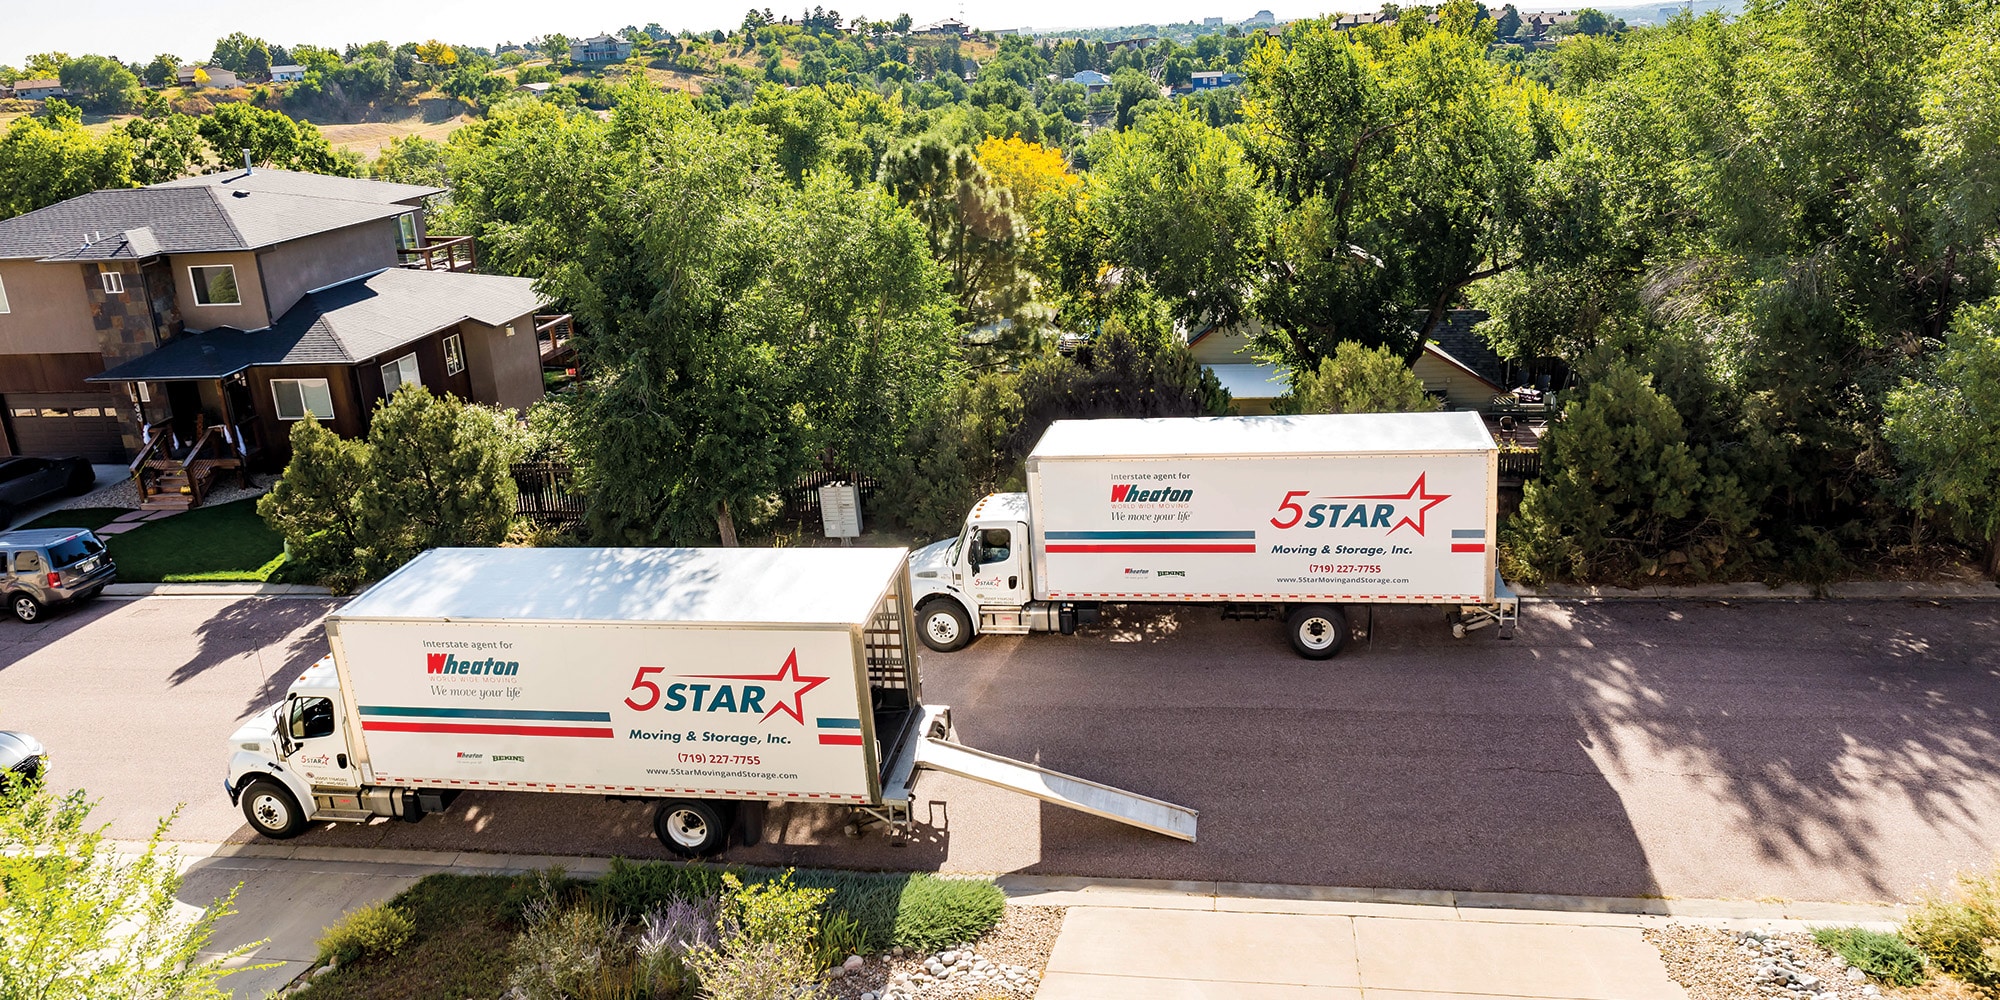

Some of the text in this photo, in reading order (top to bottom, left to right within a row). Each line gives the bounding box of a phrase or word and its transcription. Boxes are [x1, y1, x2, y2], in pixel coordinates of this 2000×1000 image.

[1111, 472, 1191, 481] Interstate agent for
[1110, 484, 1194, 502] Wheaton
[1269, 490, 1395, 530] 5 STAR
[1111, 511, 1126, 520] We
[1128, 513, 1152, 521] move
[1153, 513, 1176, 523] your
[1271, 544, 1413, 556] Moving & Storage, Inc.
[1309, 564, 1381, 573] (719) 227-7755
[1276, 576, 1409, 585] www.5StarMovingandStorage.com
[423, 640, 513, 650] Interstate agent for
[427, 653, 519, 675] Wheaton
[431, 685, 447, 696] We
[450, 688, 477, 697] move
[479, 689, 503, 699] your
[623, 666, 766, 714] 5 STAR
[629, 729, 792, 745] Moving & Storage, Inc.
[678, 752, 761, 765] (719) 227-7755
[646, 767, 798, 780] www.5StarMovingandStorage.com
